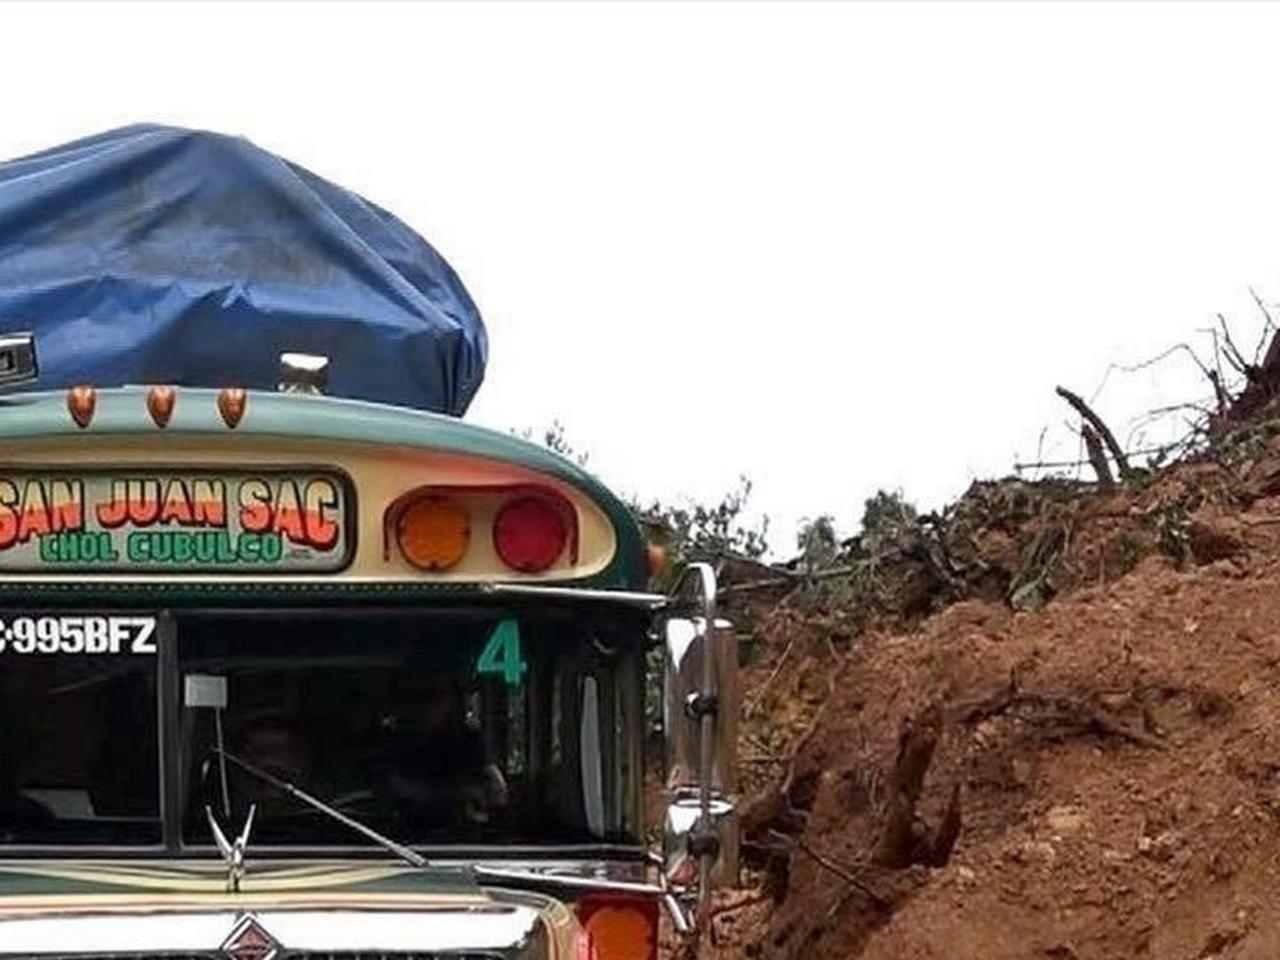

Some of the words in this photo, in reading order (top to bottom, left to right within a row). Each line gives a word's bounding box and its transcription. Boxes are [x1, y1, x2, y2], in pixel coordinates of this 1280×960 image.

[40, 531, 119, 562] CHOL
[127, 531, 282, 563] CUBULCO
[96, 478, 227, 529] JUAN
[239, 477, 339, 551] SAC
[477, 619, 527, 685] 4
